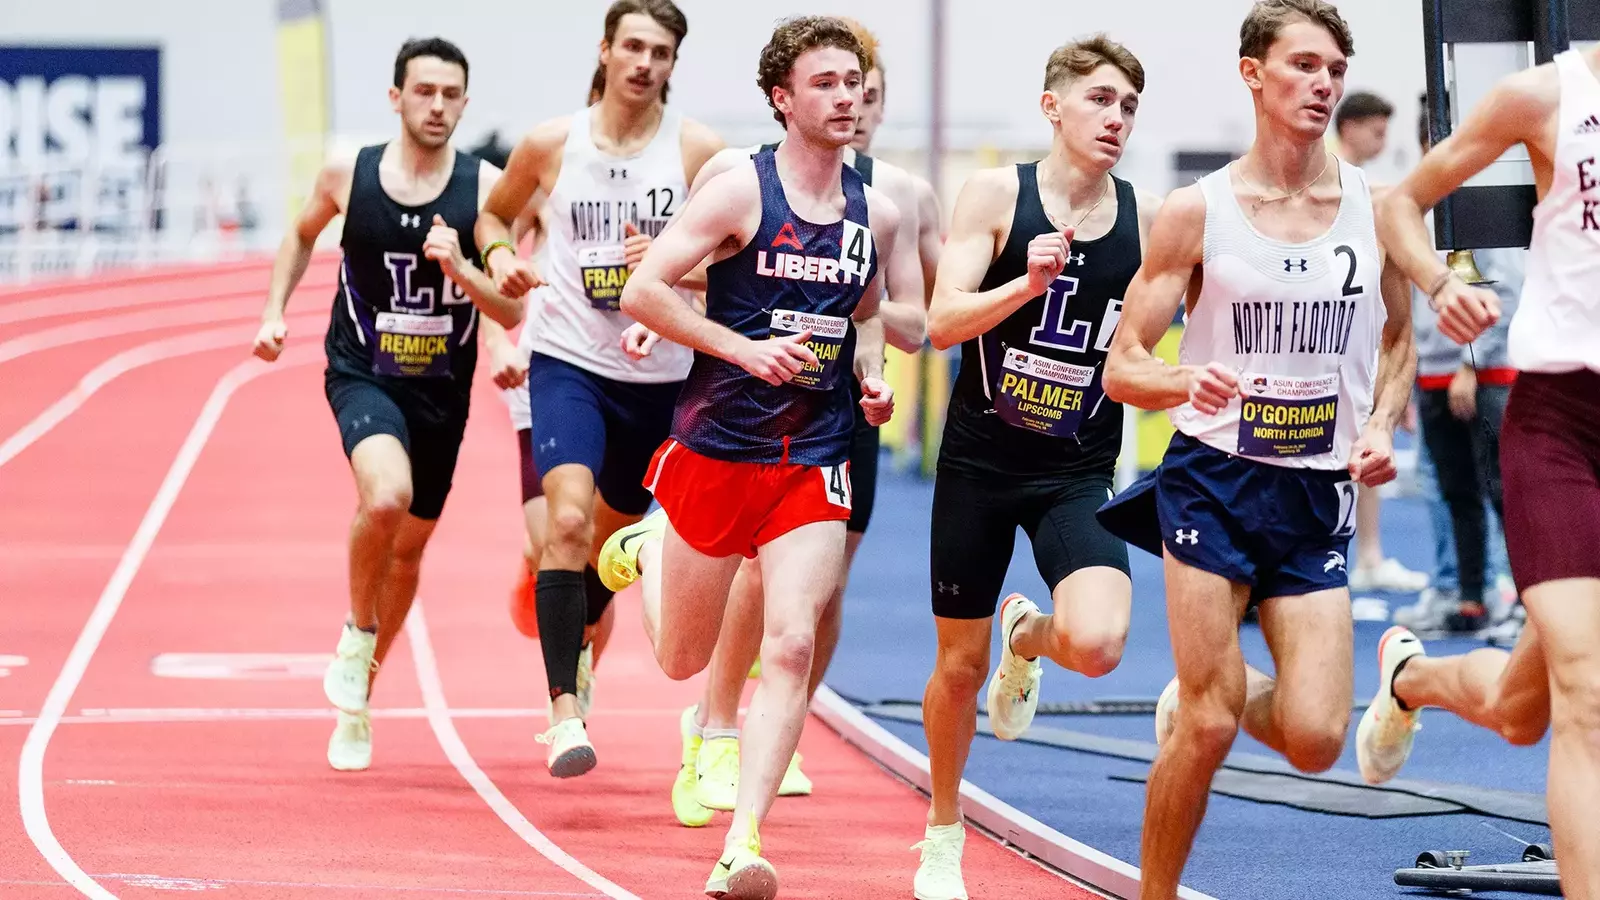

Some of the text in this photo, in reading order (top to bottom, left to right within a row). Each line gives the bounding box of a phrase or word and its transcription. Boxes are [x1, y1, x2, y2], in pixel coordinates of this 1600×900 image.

[647, 188, 674, 217] 12
[571, 201, 611, 241] NORTH
[847, 228, 866, 272] 4
[384, 251, 435, 314] L
[1334, 245, 1364, 297] 2
[800, 316, 815, 324] ASUN
[1029, 275, 1093, 353] L
[1232, 301, 1356, 355] NORTH FLORIDA
[380, 333, 448, 354] REMICK
[1033, 359, 1089, 377] ASUN CONFERENCE
[1035, 367, 1085, 383] CHAMPIONSHIPS
[1273, 380, 1293, 388] ASUN
[1001, 373, 1083, 411] PALMER
[1017, 401, 1063, 420] LIPSCOMB
[1243, 402, 1336, 425] O'GORMAN
[1253, 426, 1324, 440] NORTH FLORIDA
[830, 464, 845, 504] 4
[1337, 484, 1354, 533] 2
